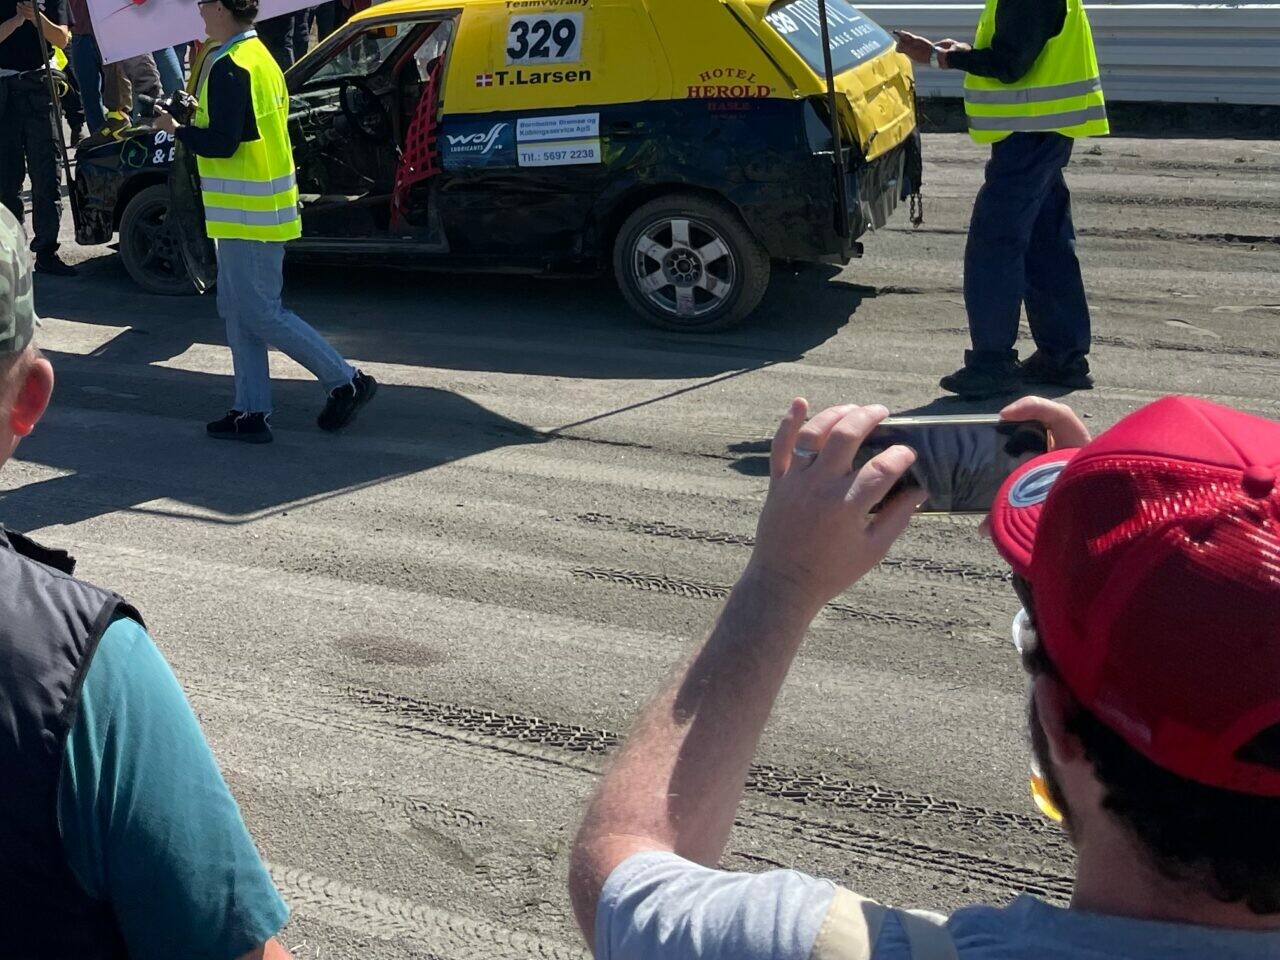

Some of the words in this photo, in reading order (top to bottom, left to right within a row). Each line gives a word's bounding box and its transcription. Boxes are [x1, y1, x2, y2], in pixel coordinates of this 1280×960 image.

[507, 18, 576, 60] 329
[495, 69, 592, 86] T.Larsen
[699, 67, 756, 84] HOTEL
[688, 85, 771, 99] HEROLD
[152, 149, 165, 163] &
[544, 151, 566, 161] 5697
[570, 149, 594, 159] 2238
